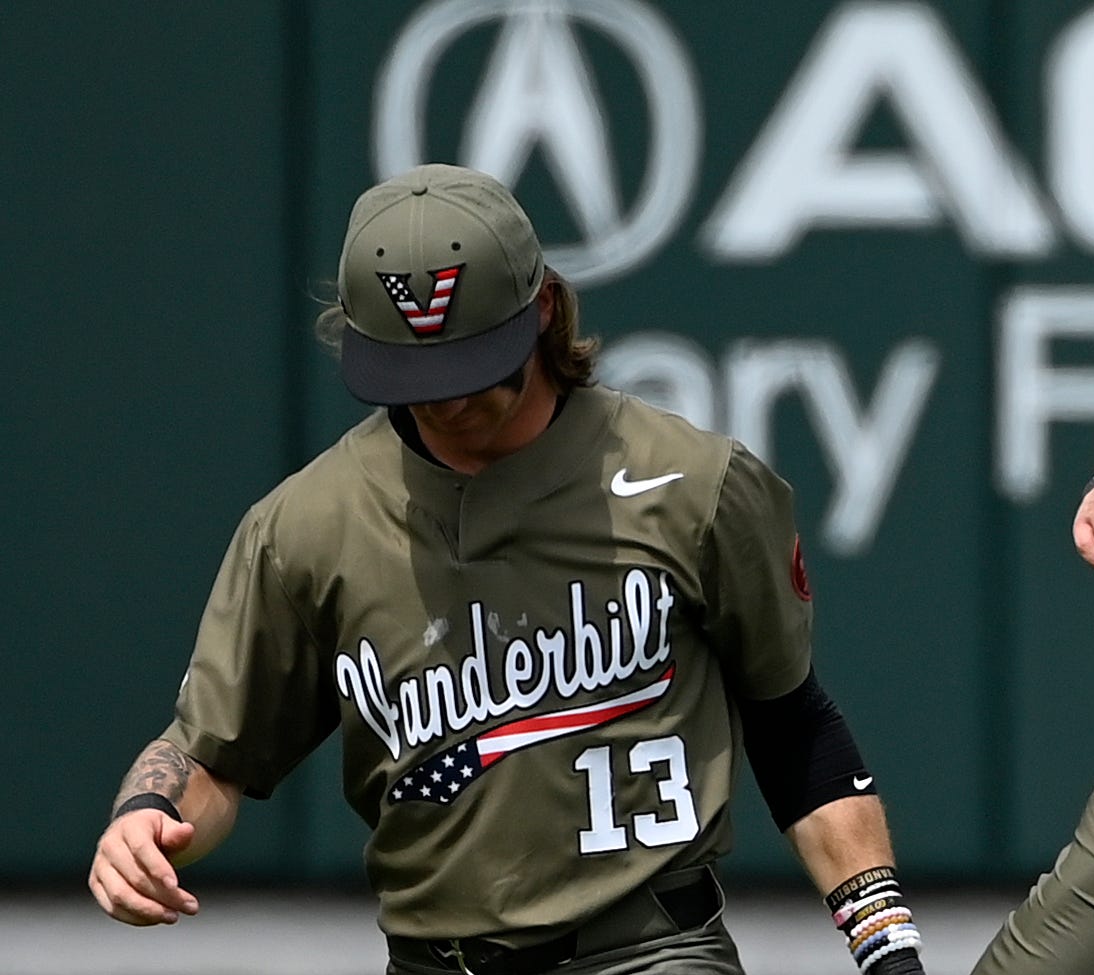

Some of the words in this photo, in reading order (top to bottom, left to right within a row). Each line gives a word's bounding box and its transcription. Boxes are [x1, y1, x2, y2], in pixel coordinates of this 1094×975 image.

[375, 262, 466, 340] V
[597, 333, 938, 555] ary
[335, 567, 675, 761] Vanderbilt
[573, 734, 700, 855] 13
